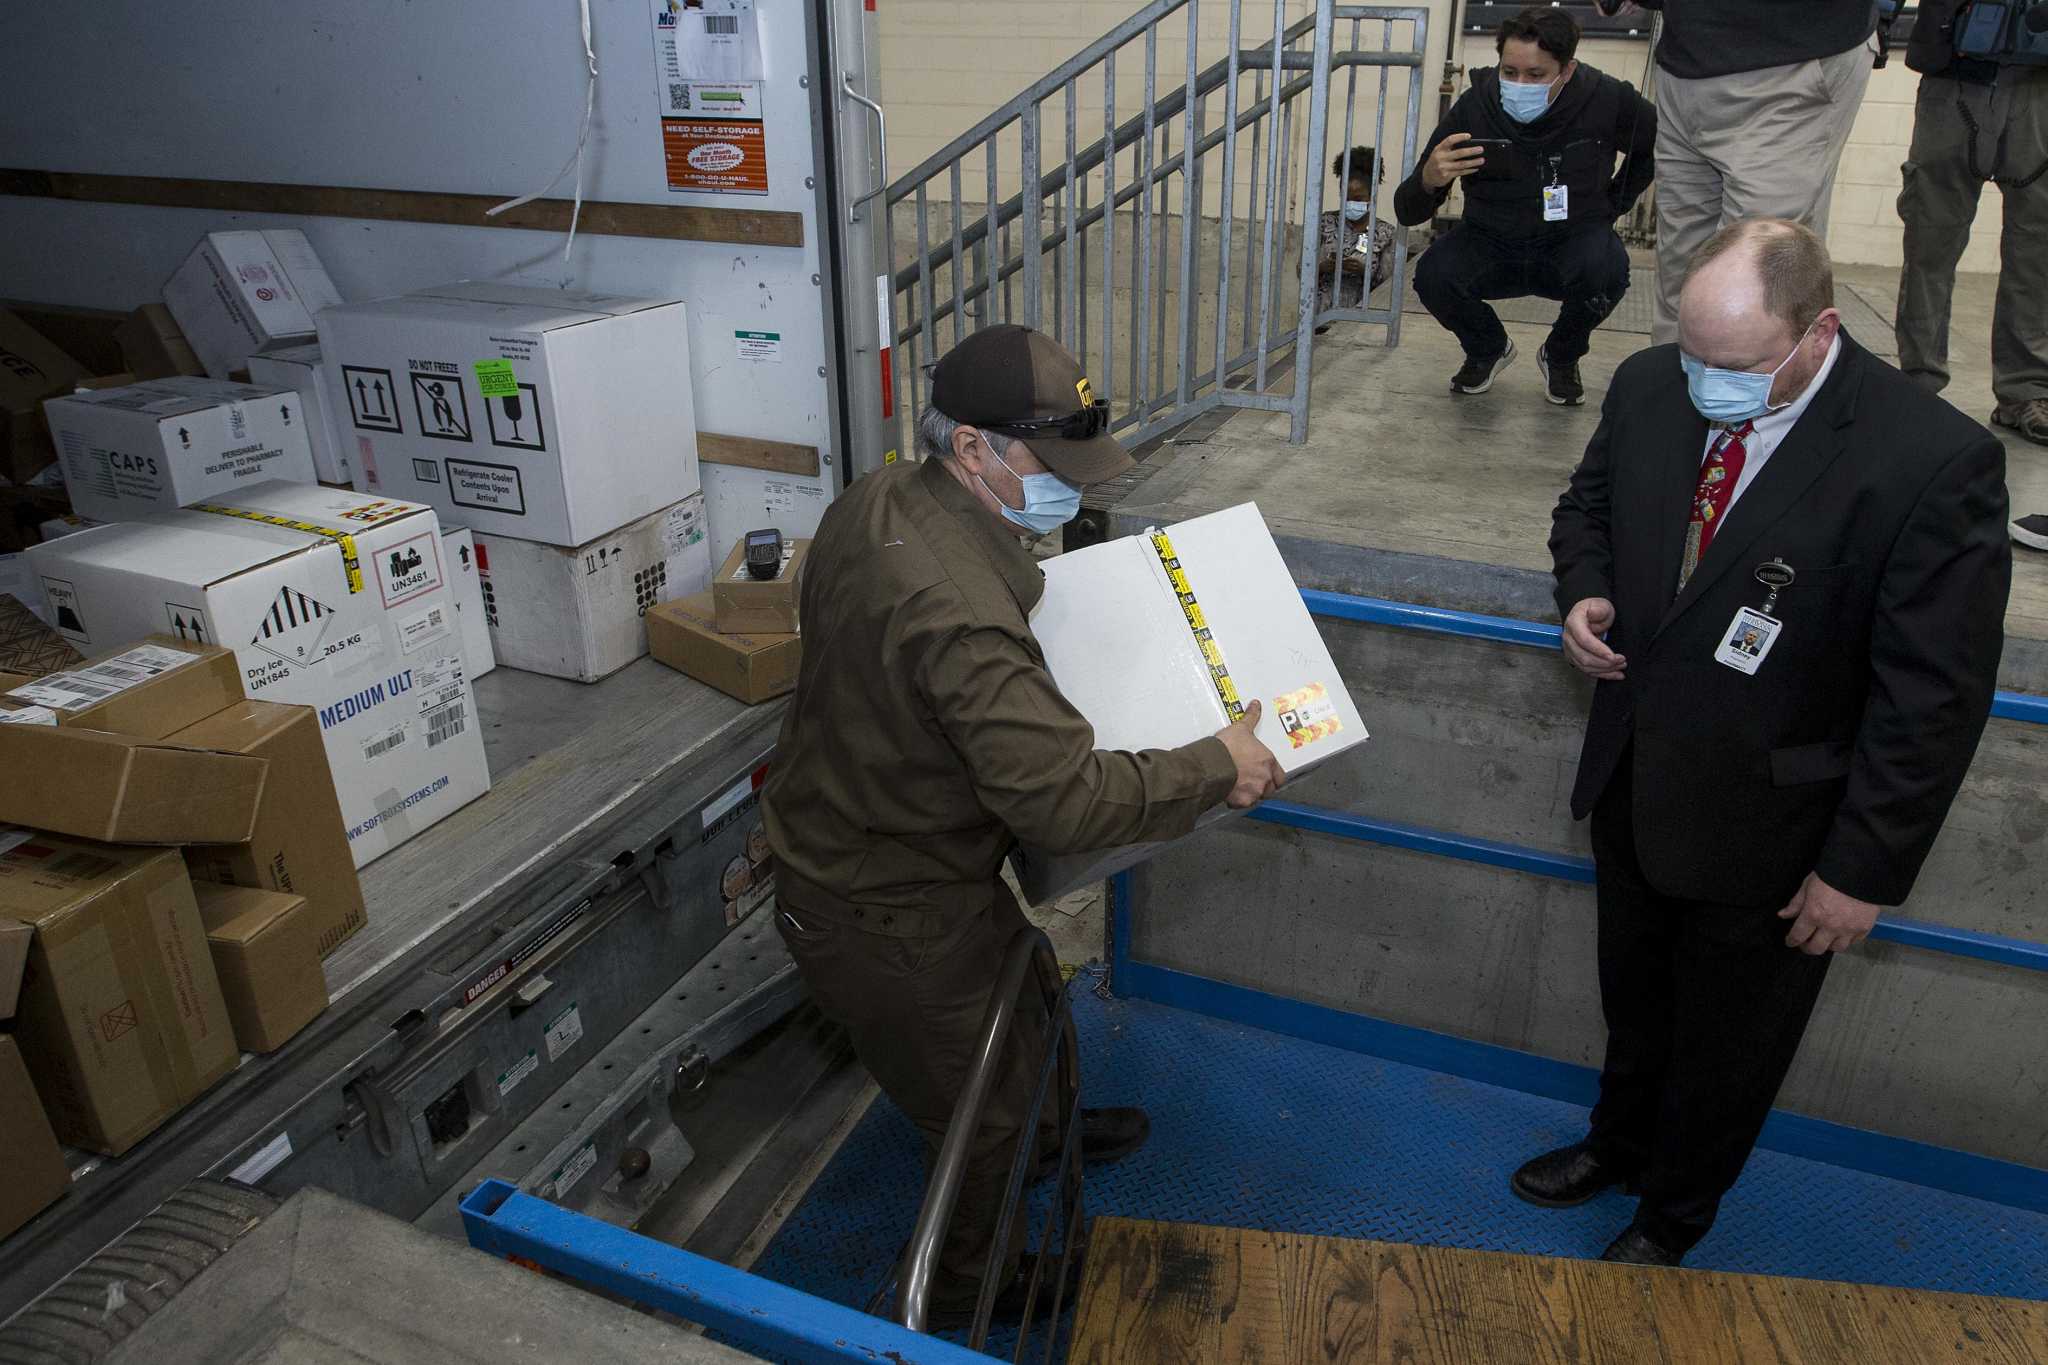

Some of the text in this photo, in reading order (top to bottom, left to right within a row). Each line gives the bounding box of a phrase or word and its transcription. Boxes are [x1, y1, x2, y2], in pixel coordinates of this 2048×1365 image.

[666, 125, 760, 134] NEED SELF-STORAGE
[710, 153, 740, 162] STORAGE
[408, 359, 459, 374] DO NOT FREEZE
[480, 374, 513, 384] URGENT
[205, 448, 284, 475] DELIVER TO PHARMACY
[221, 443, 264, 460] PERISHABLE
[110, 451, 158, 475] CAPS
[233, 465, 263, 479] FRAGILE
[453, 467, 513, 483] Refrigerate Cooler
[461, 480, 510, 495] Contents Upon
[476, 493, 498, 503] Arrival
[392, 570, 429, 592] UN3481
[1163, 561, 1177, 585] CAUTION
[1179, 596, 1193, 620] CAUTION
[324, 633, 361, 656] 20.5 KG
[248, 657, 284, 680] Dry Ice
[251, 668, 290, 690] UN1845
[320, 682, 385, 730] MEDIUM
[273, 848, 285, 873] The
[466, 964, 508, 1001] DANGER
